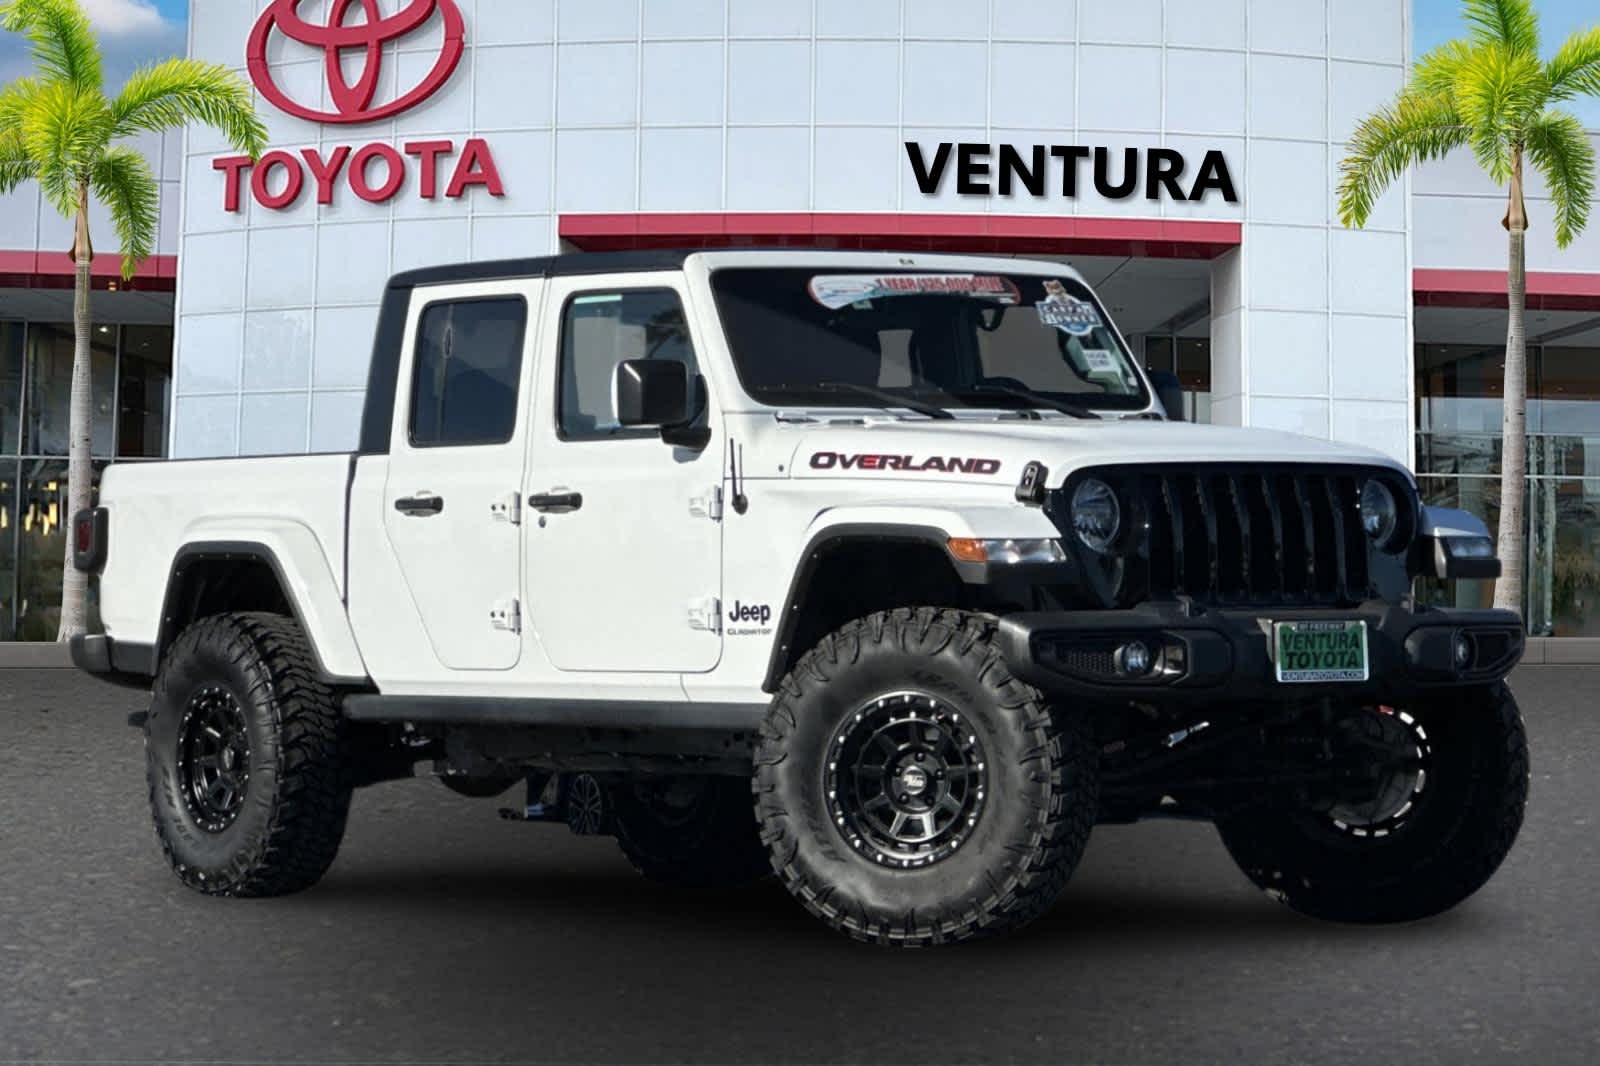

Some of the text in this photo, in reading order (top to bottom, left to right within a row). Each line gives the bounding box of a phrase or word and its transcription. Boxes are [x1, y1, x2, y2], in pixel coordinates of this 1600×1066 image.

[212, 138, 505, 212] TOYOTA
[904, 141, 1239, 203] VENTURA
[809, 451, 1002, 475] OVERLAND
[729, 600, 771, 626] Jeep
[1281, 632, 1361, 650] VENTURA
[1286, 650, 1358, 669] TOYOTA
